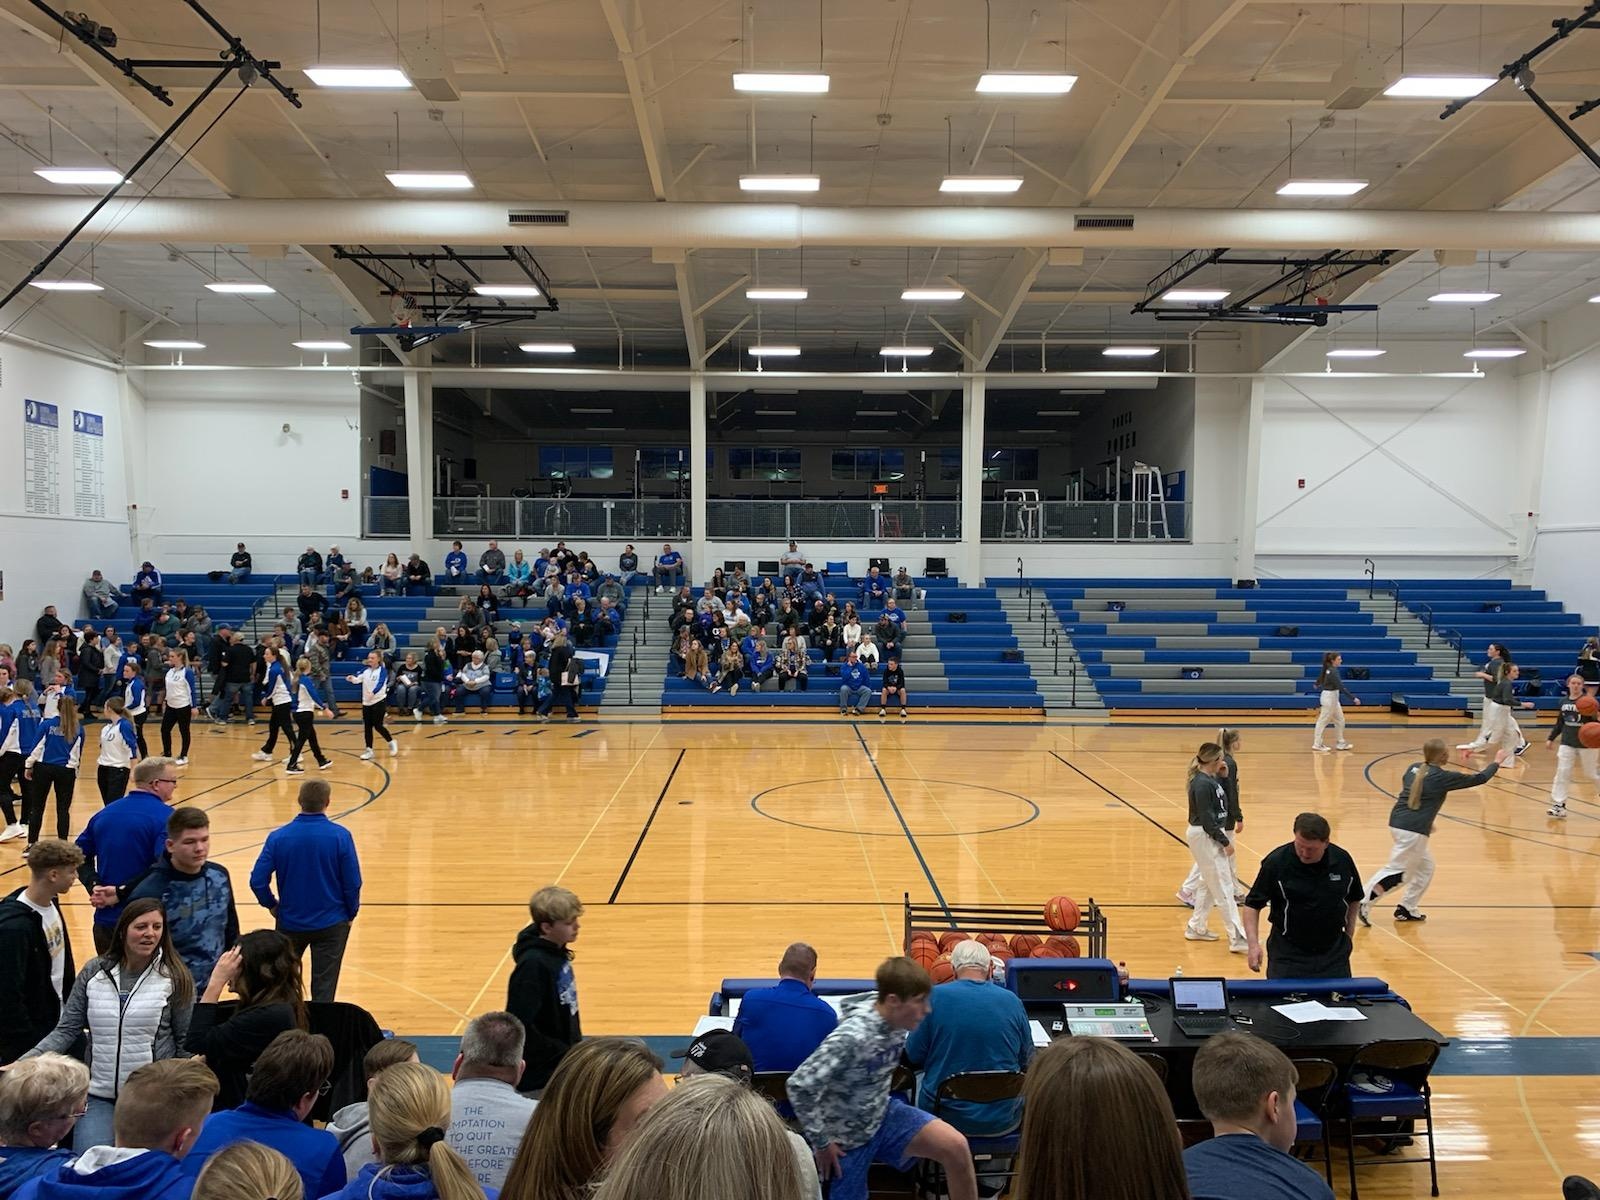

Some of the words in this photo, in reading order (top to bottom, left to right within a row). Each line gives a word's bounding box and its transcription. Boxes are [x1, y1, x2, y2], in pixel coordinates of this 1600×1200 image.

[464, 1106, 484, 1116] THE
[452, 1119, 505, 1129] MPTATION
[449, 1133, 464, 1142] TO
[466, 1131, 493, 1142] QUIT
[468, 1159, 504, 1169] EFORE
